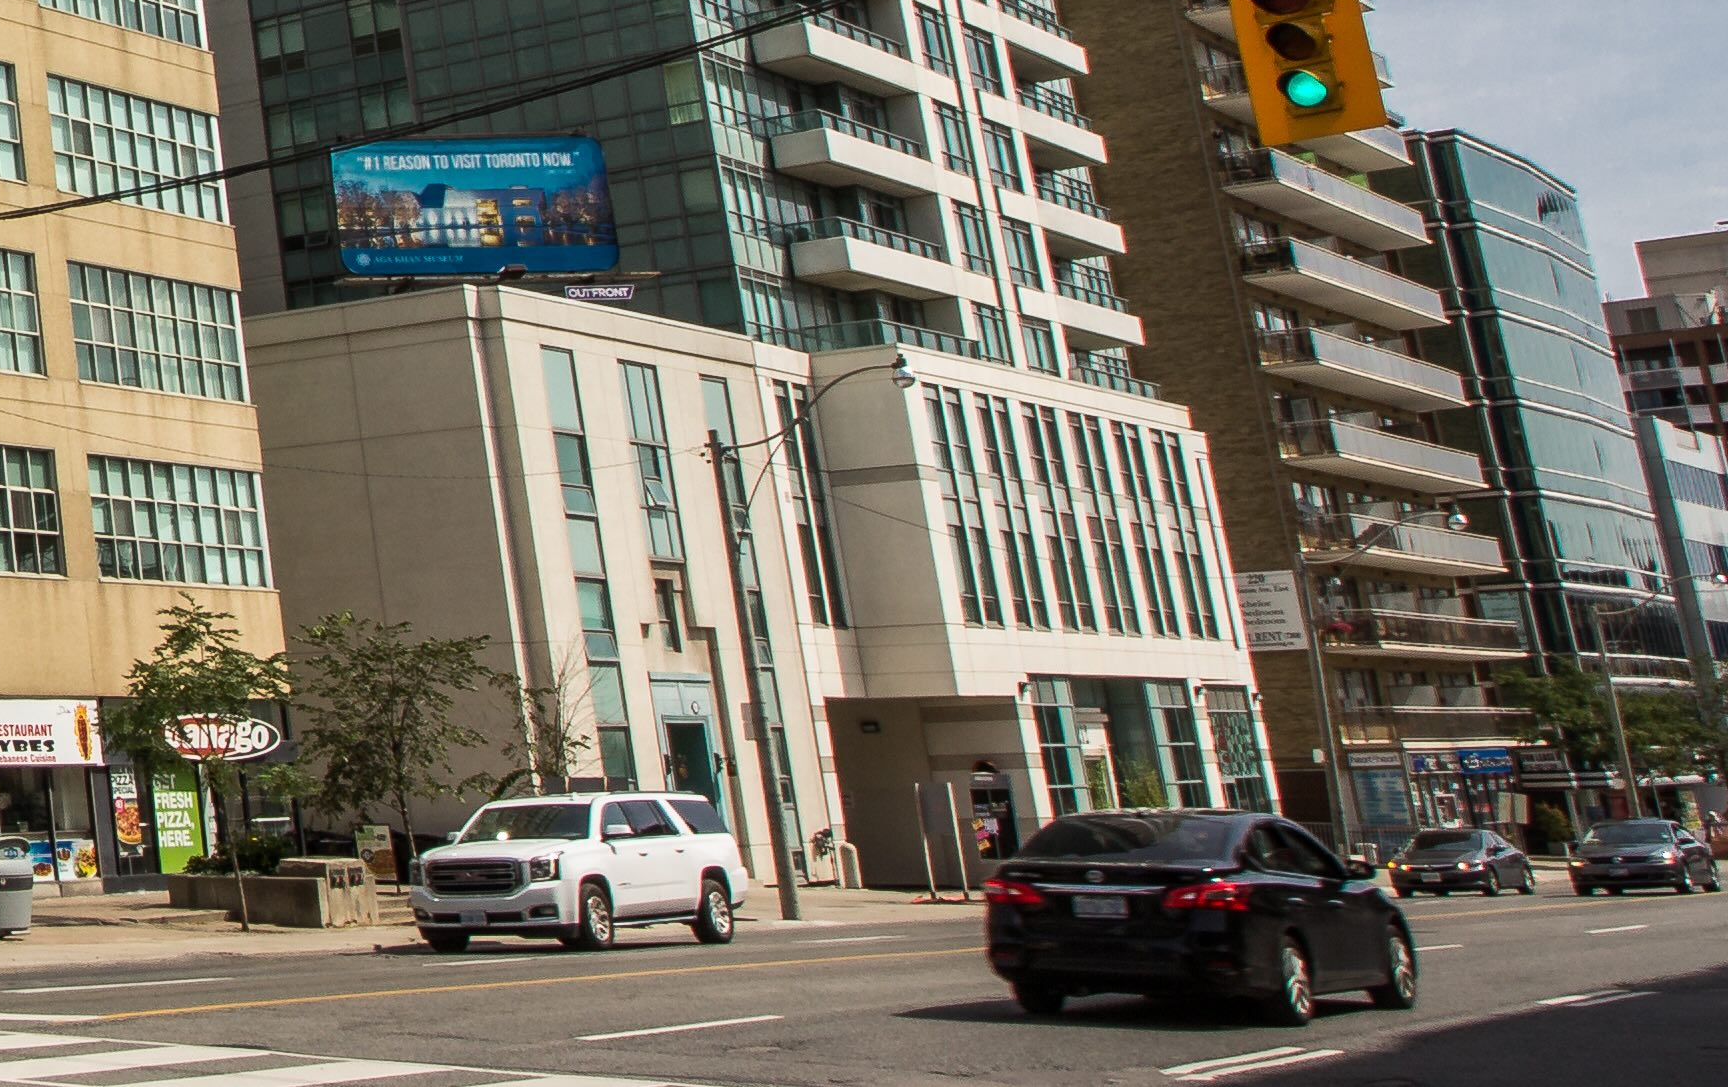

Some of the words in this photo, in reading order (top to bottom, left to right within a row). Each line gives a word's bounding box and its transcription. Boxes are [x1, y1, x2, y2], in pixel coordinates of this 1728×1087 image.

[383, 155, 431, 171] REASON
[431, 155, 449, 170] TO
[450, 154, 482, 170] VISIT
[485, 153, 541, 170] TORONTO
[394, 255, 422, 263] KHAN
[423, 254, 464, 263] MUSEUM
[568, 286, 630, 300] OUTFRONT
[30, 754, 57, 763] Cuisine
[110, 775, 134, 786] PIZZA
[153, 773, 176, 790] GET
[154, 792, 193, 809] FRESH
[156, 811, 195, 830] PIZZA,
[158, 830, 193, 848] HERE.
